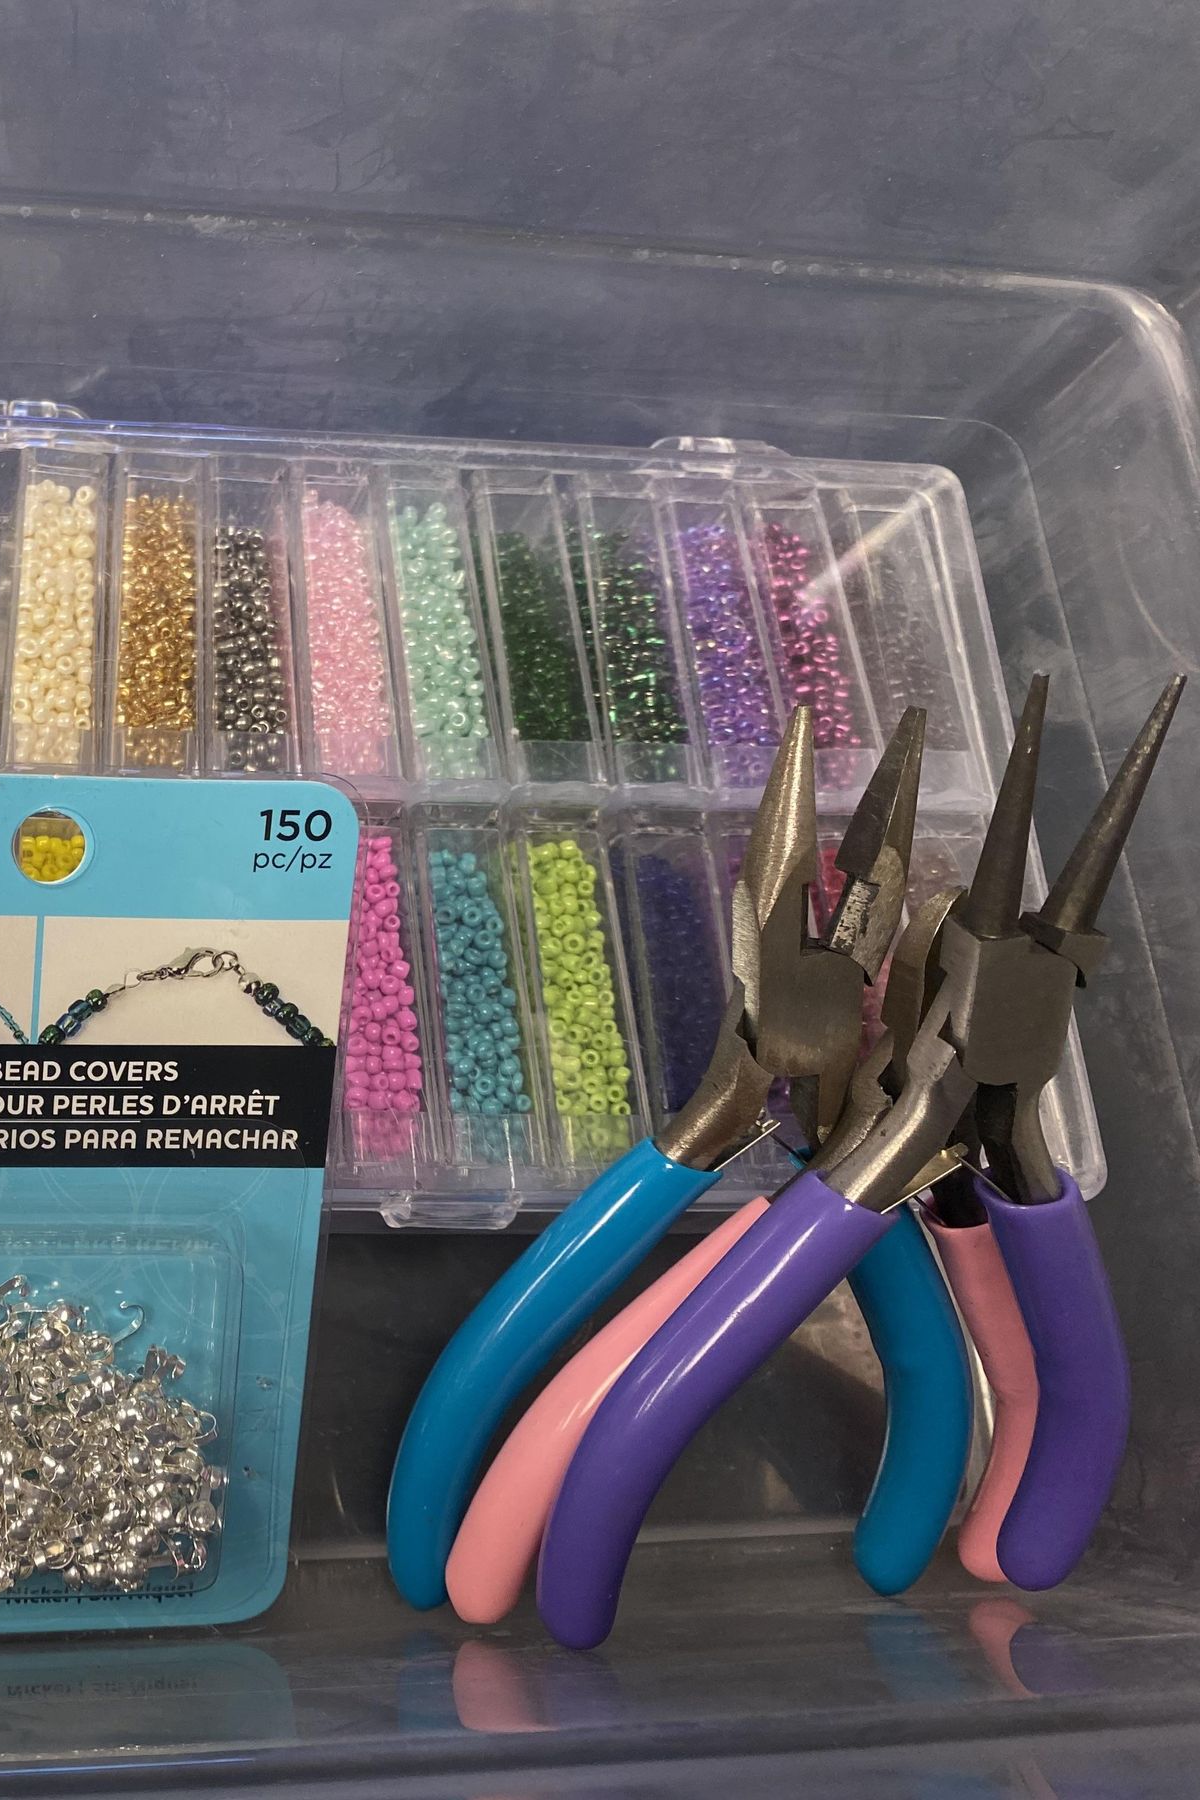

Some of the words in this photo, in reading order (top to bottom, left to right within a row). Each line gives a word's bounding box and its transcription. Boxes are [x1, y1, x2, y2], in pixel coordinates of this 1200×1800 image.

[259, 809, 332, 842] 150
[253, 846, 332, 873] pc/pz
[69, 1060, 179, 1082] COVERS
[52, 1094, 155, 1116] PERLES
[162, 1089, 280, 1116] D'ARRÊT
[64, 1129, 137, 1150] PARA
[143, 1129, 299, 1151] REMACHAR
